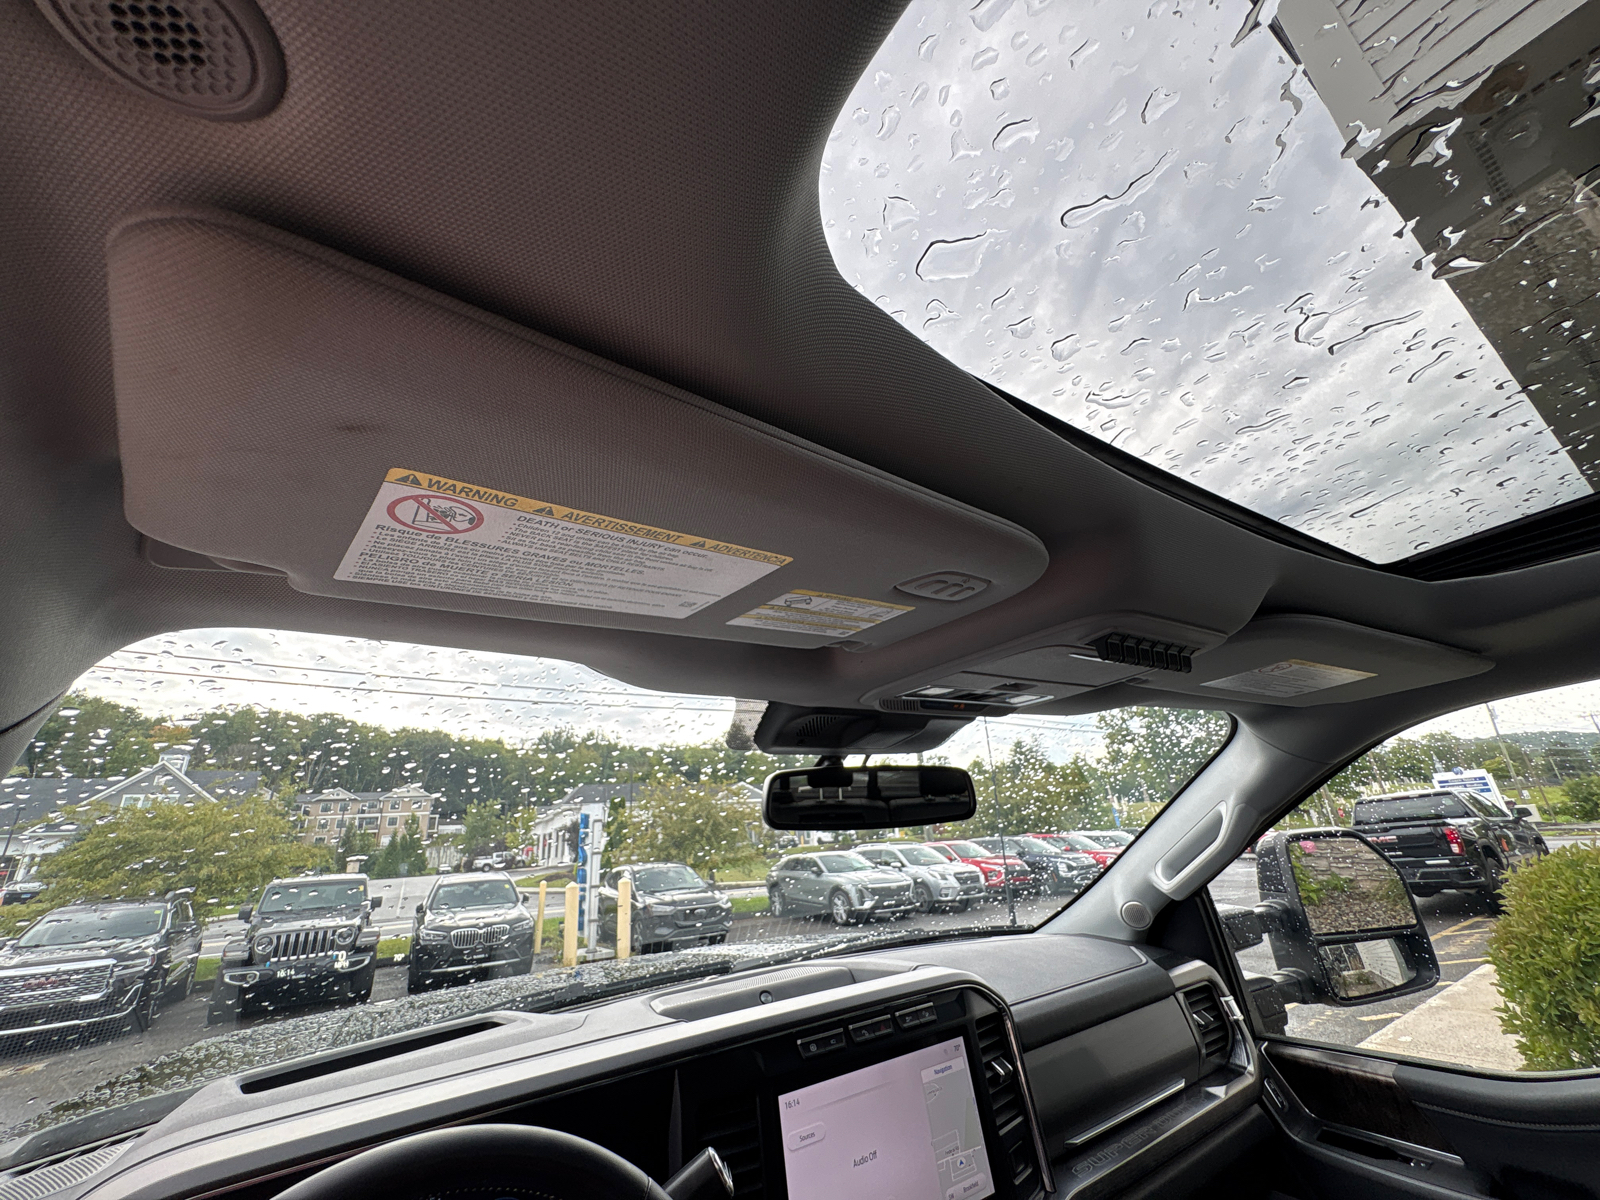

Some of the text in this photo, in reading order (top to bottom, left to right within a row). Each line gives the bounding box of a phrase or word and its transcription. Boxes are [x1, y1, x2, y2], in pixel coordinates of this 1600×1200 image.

[424, 478, 519, 507] WARNING
[517, 515, 560, 529] DEATH
[575, 528, 626, 542] SERIOUS
[626, 539, 665, 549] INJURY
[561, 511, 684, 542] AVERTISSEMENT
[397, 535, 428, 543] enfants
[509, 532, 537, 540] NEVER
[529, 531, 552, 539] BACK
[375, 524, 423, 537] Risque
[445, 537, 520, 554] BLESSURES
[522, 551, 568, 562] GRAVES
[501, 540, 534, 549] ALWAYS
[707, 544, 787, 565] ADVERTENCIA
[359, 552, 419, 564] PELIGRO
[439, 564, 489, 575] MUERTE
[334, 960, 349, 968] MPH
[276, 968, 296, 978] 16:14
[934, 1064, 953, 1075] Navigation
[785, 1098, 800, 1110] 16:14
[799, 1132, 815, 1142] Sources
[1072, 1126, 1154, 1178] SUPER
[853, 1150, 878, 1168] Audio Off
